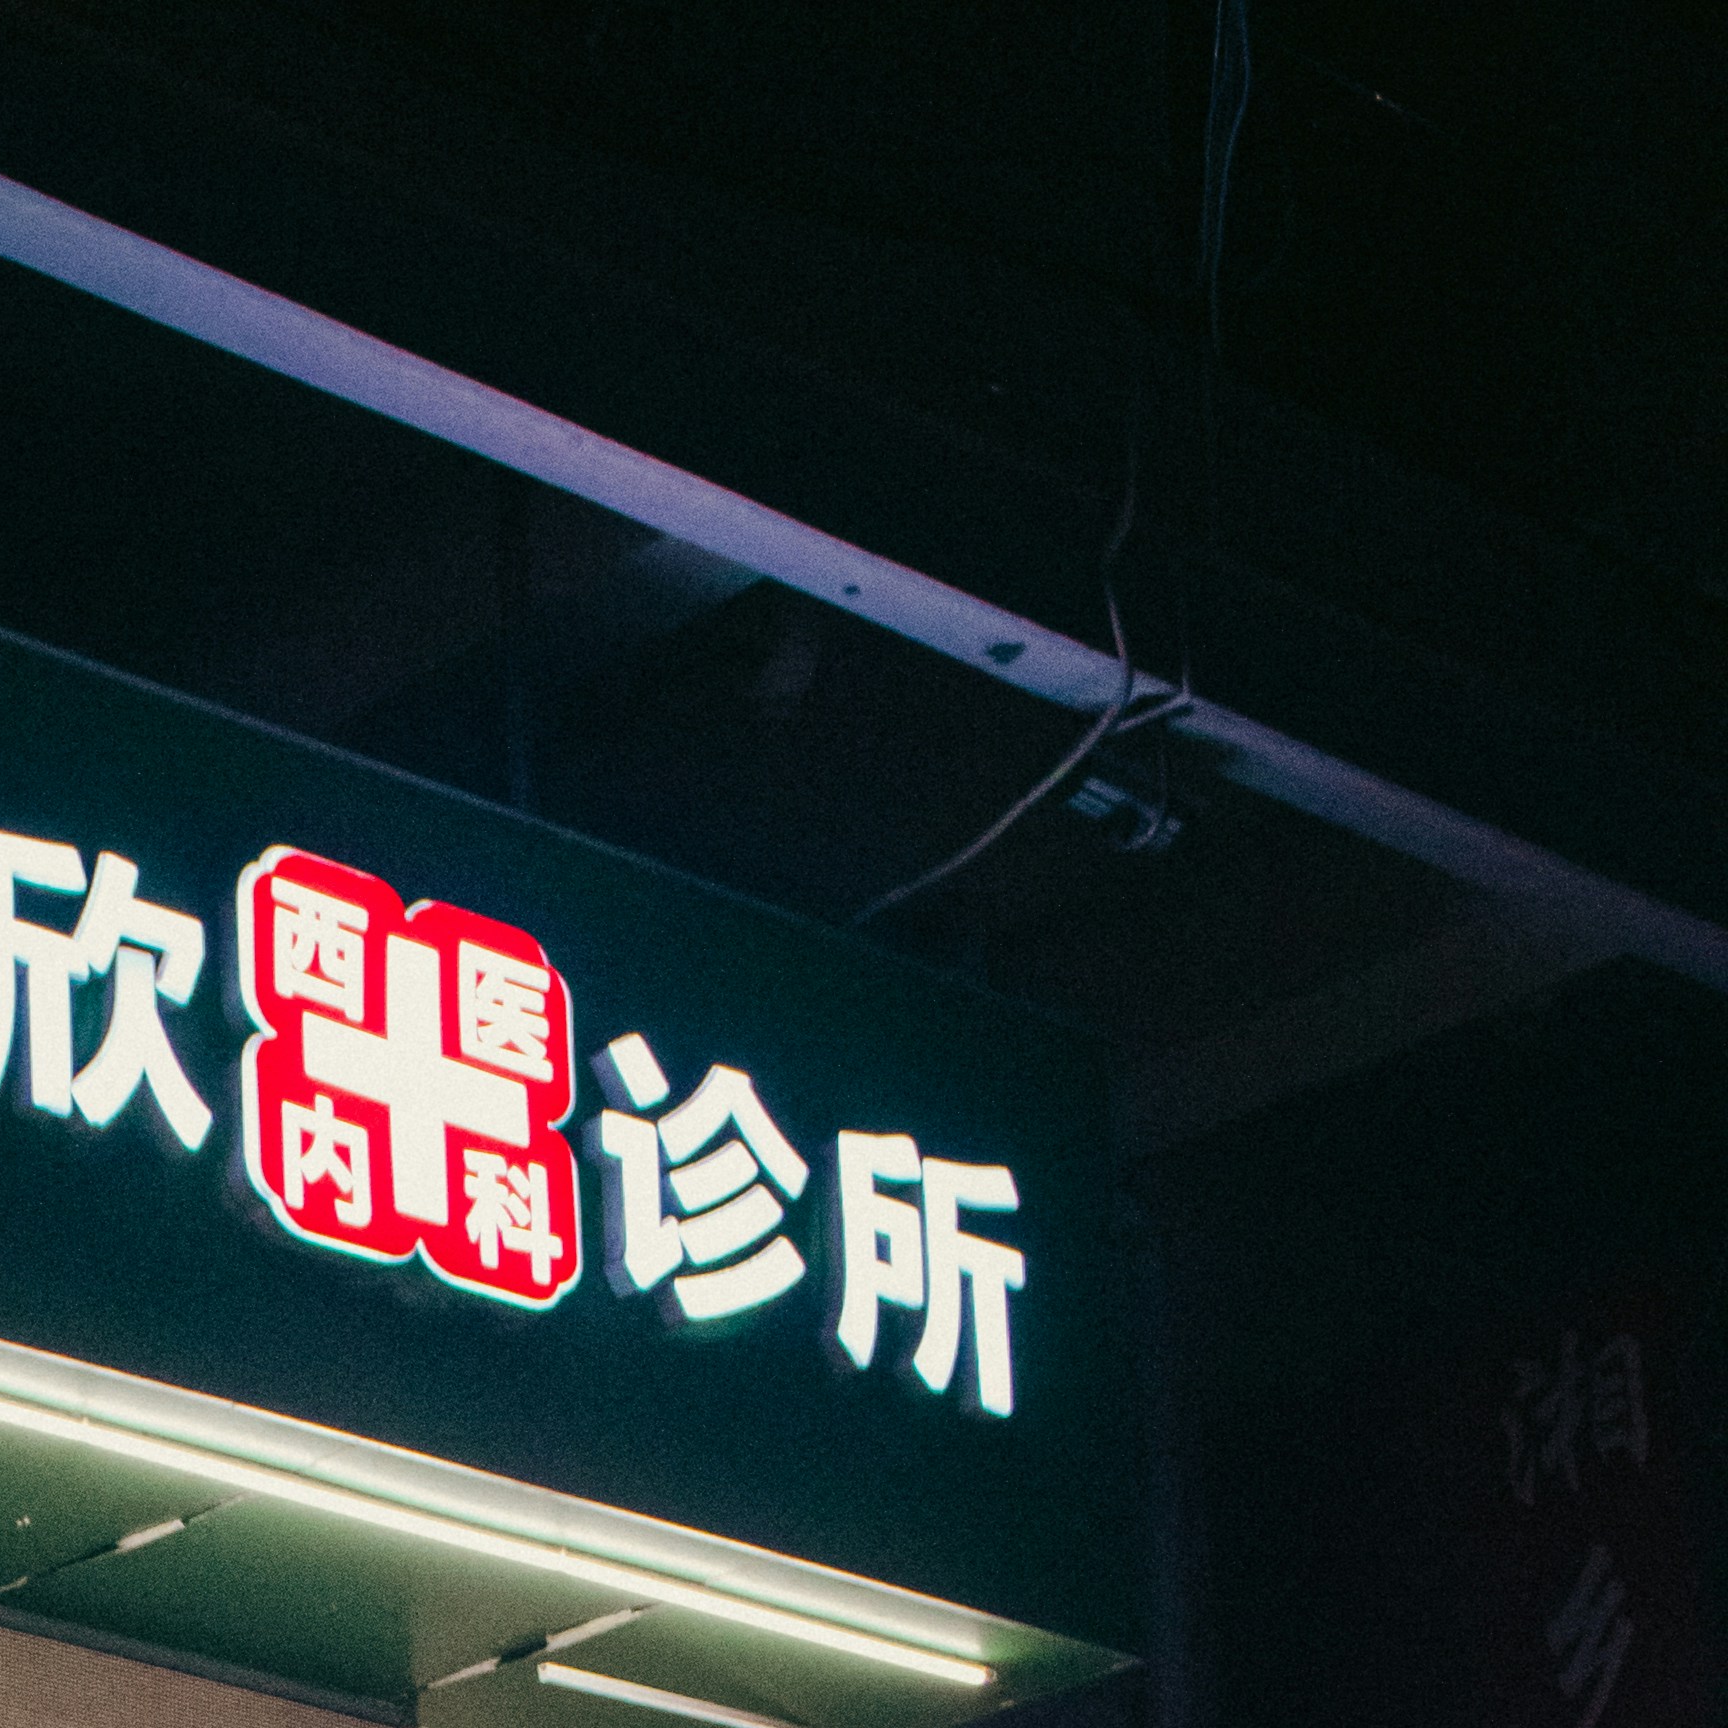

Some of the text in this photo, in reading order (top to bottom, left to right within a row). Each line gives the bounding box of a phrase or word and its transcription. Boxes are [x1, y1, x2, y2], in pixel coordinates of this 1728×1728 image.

[270, 877, 553, 1082] 西医
[281, 1094, 562, 1286] 内科
[602, 1033, 1024, 1417] 诊所
